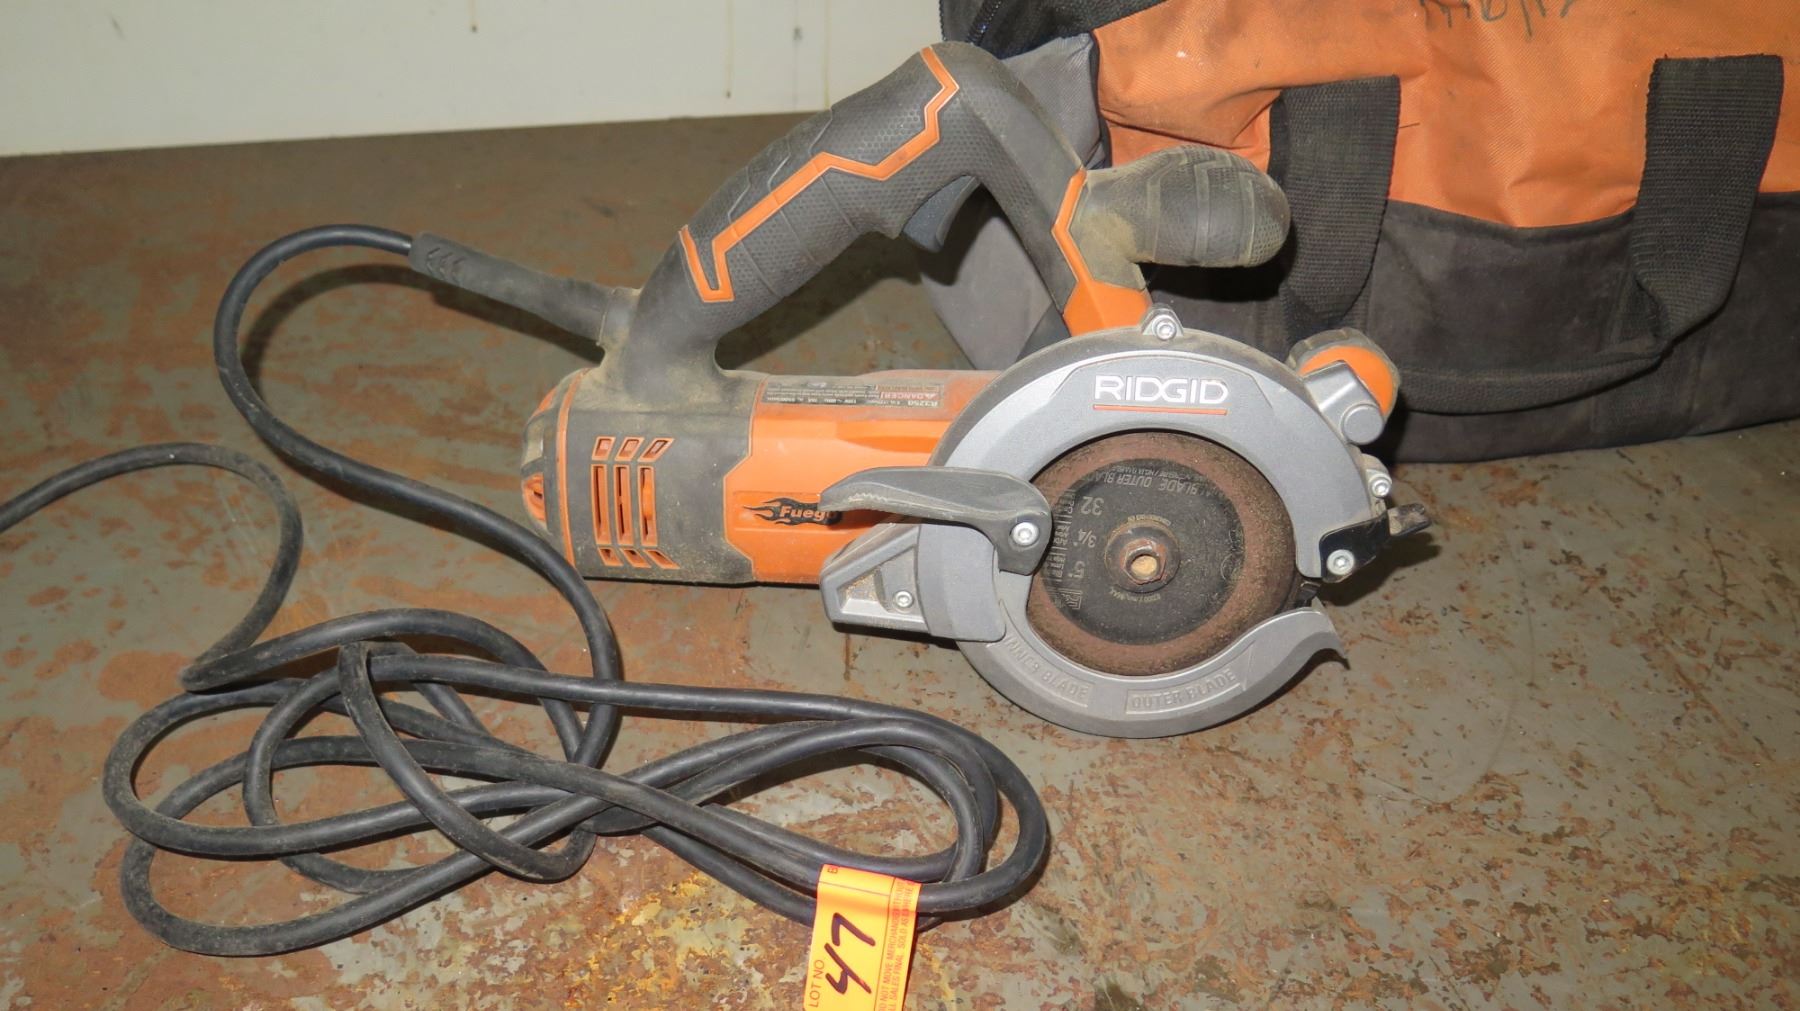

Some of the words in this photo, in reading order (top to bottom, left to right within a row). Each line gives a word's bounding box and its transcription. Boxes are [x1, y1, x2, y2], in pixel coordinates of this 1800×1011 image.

[1094, 375, 1229, 404] RIDGID
[1116, 473, 1153, 488] OUTER
[1080, 496, 1105, 516] 32
[1041, 670, 1091, 699] BLADE
[1131, 690, 1183, 709] OUTER
[1185, 668, 1237, 700] BLADE
[823, 912, 876, 995] 47
[889, 975, 900, 1001] SALES
[897, 927, 907, 949] SOLD
[812, 959, 825, 980] NO
[882, 962, 893, 984] MOVE
[809, 982, 821, 1008] LOT
[880, 985, 889, 1002] NOT
